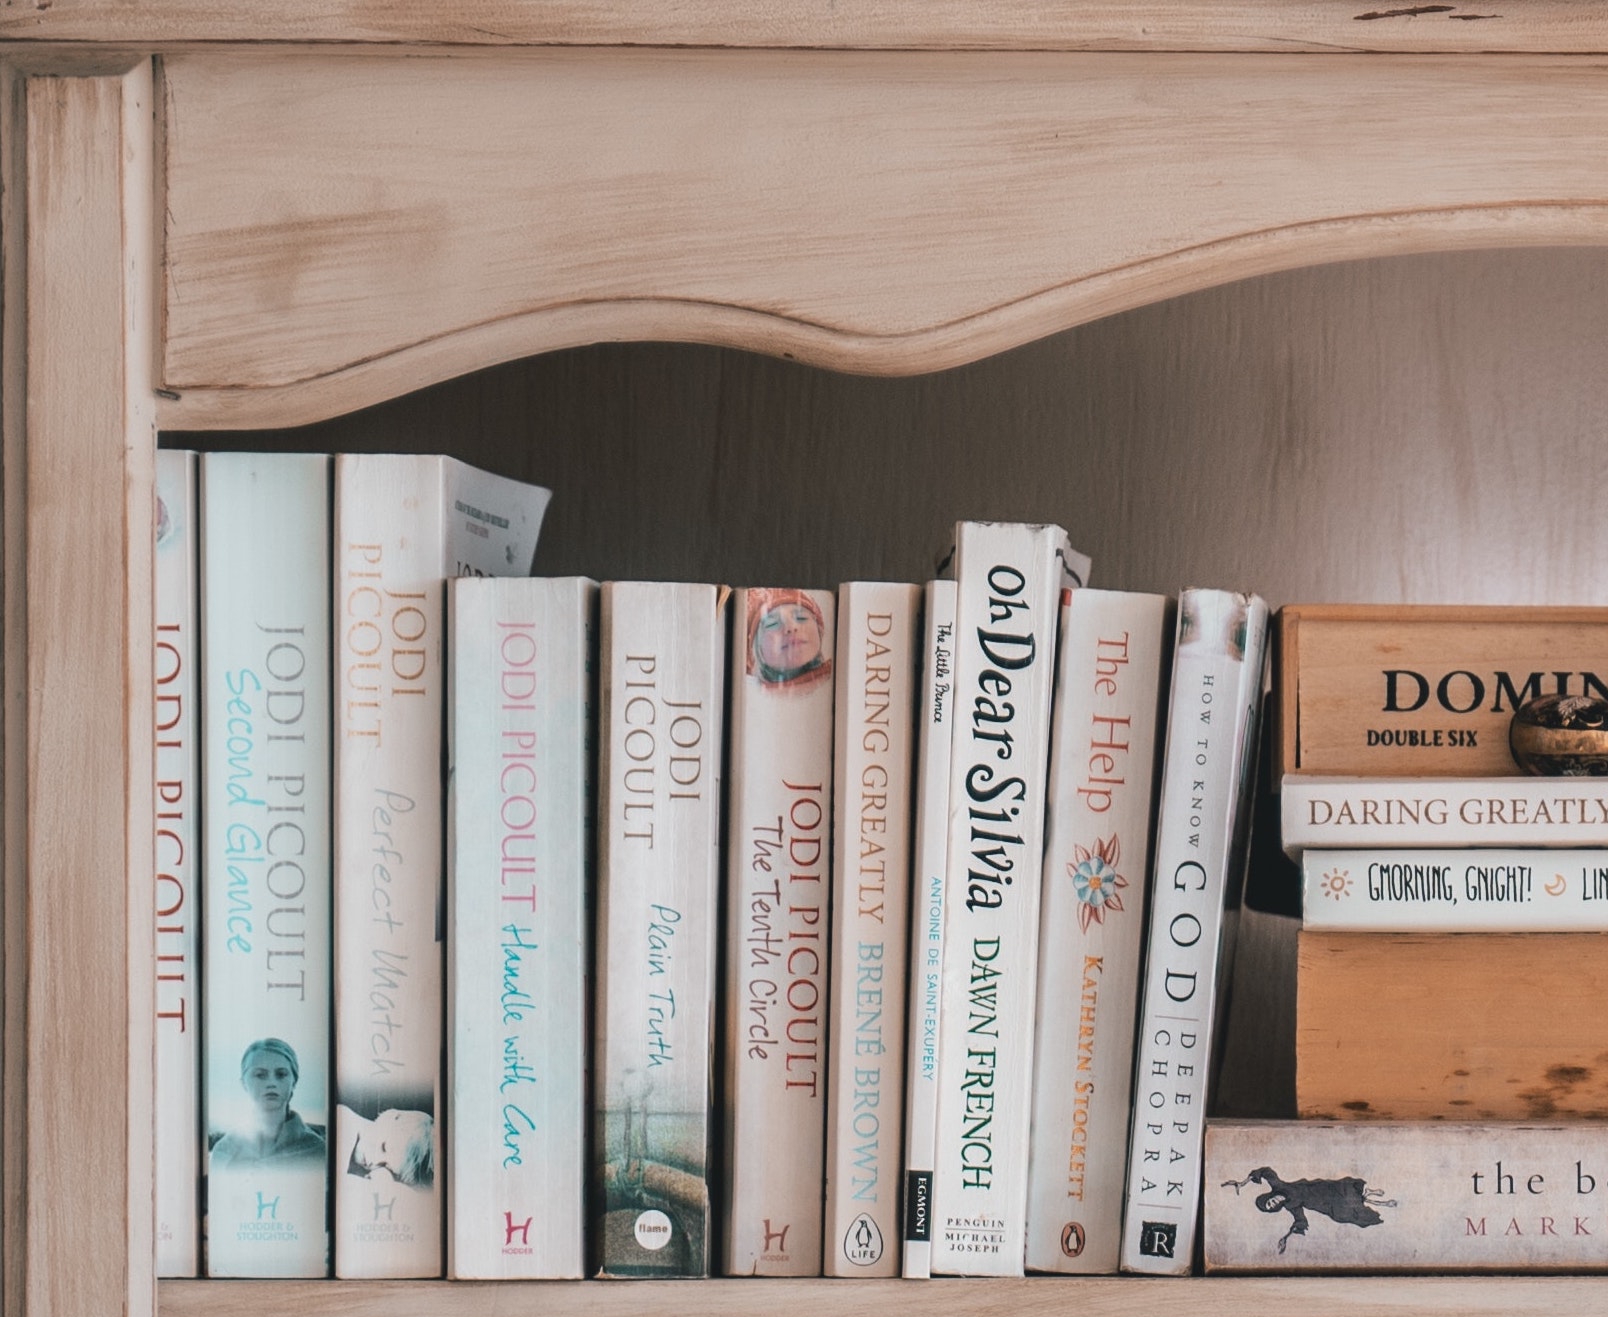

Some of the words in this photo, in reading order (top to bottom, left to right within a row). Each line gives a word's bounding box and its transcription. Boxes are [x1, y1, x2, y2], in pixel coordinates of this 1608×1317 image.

[935, 646, 949, 678] Little
[936, 624, 952, 642] The
[1095, 632, 1129, 695] The
[497, 621, 536, 721] JODI
[932, 683, 947, 722] Prince
[973, 627, 1036, 760] Dear
[1199, 675, 1214, 724] HOW
[1084, 713, 1130, 812] Help
[1196, 739, 1209, 766] TO
[1366, 730, 1444, 746] DOUBLE
[1447, 730, 1476, 746] SIX
[500, 730, 536, 912] PICOULT
[965, 765, 1026, 912] Silvia
[1188, 781, 1204, 848] KNOW
[928, 877, 941, 940] ANTOINE
[1367, 863, 1456, 905] GMORNING,
[1464, 866, 1531, 903] GNIGHT!
[928, 949, 937, 965] DE
[1162, 860, 1207, 1003] GOD
[500, 923, 535, 1026] Handle
[968, 938, 1002, 1038] DAWN
[922, 974, 939, 1081] SAINT-EXUPÉRY
[1076, 955, 1104, 1072] KATHRYN
[500, 1036, 532, 1094] with
[502, 1103, 535, 1170] Care
[962, 1047, 996, 1190] FRENCH
[1068, 1081, 1095, 1202] STOCKETT
[1140, 1030, 1172, 1194] CHOPRA
[1167, 1032, 1196, 1197] DEEPAK
[916, 1178, 927, 1235] EGMONT
[1470, 1162, 1544, 1195] the
[638, 1224, 667, 1233] flame
